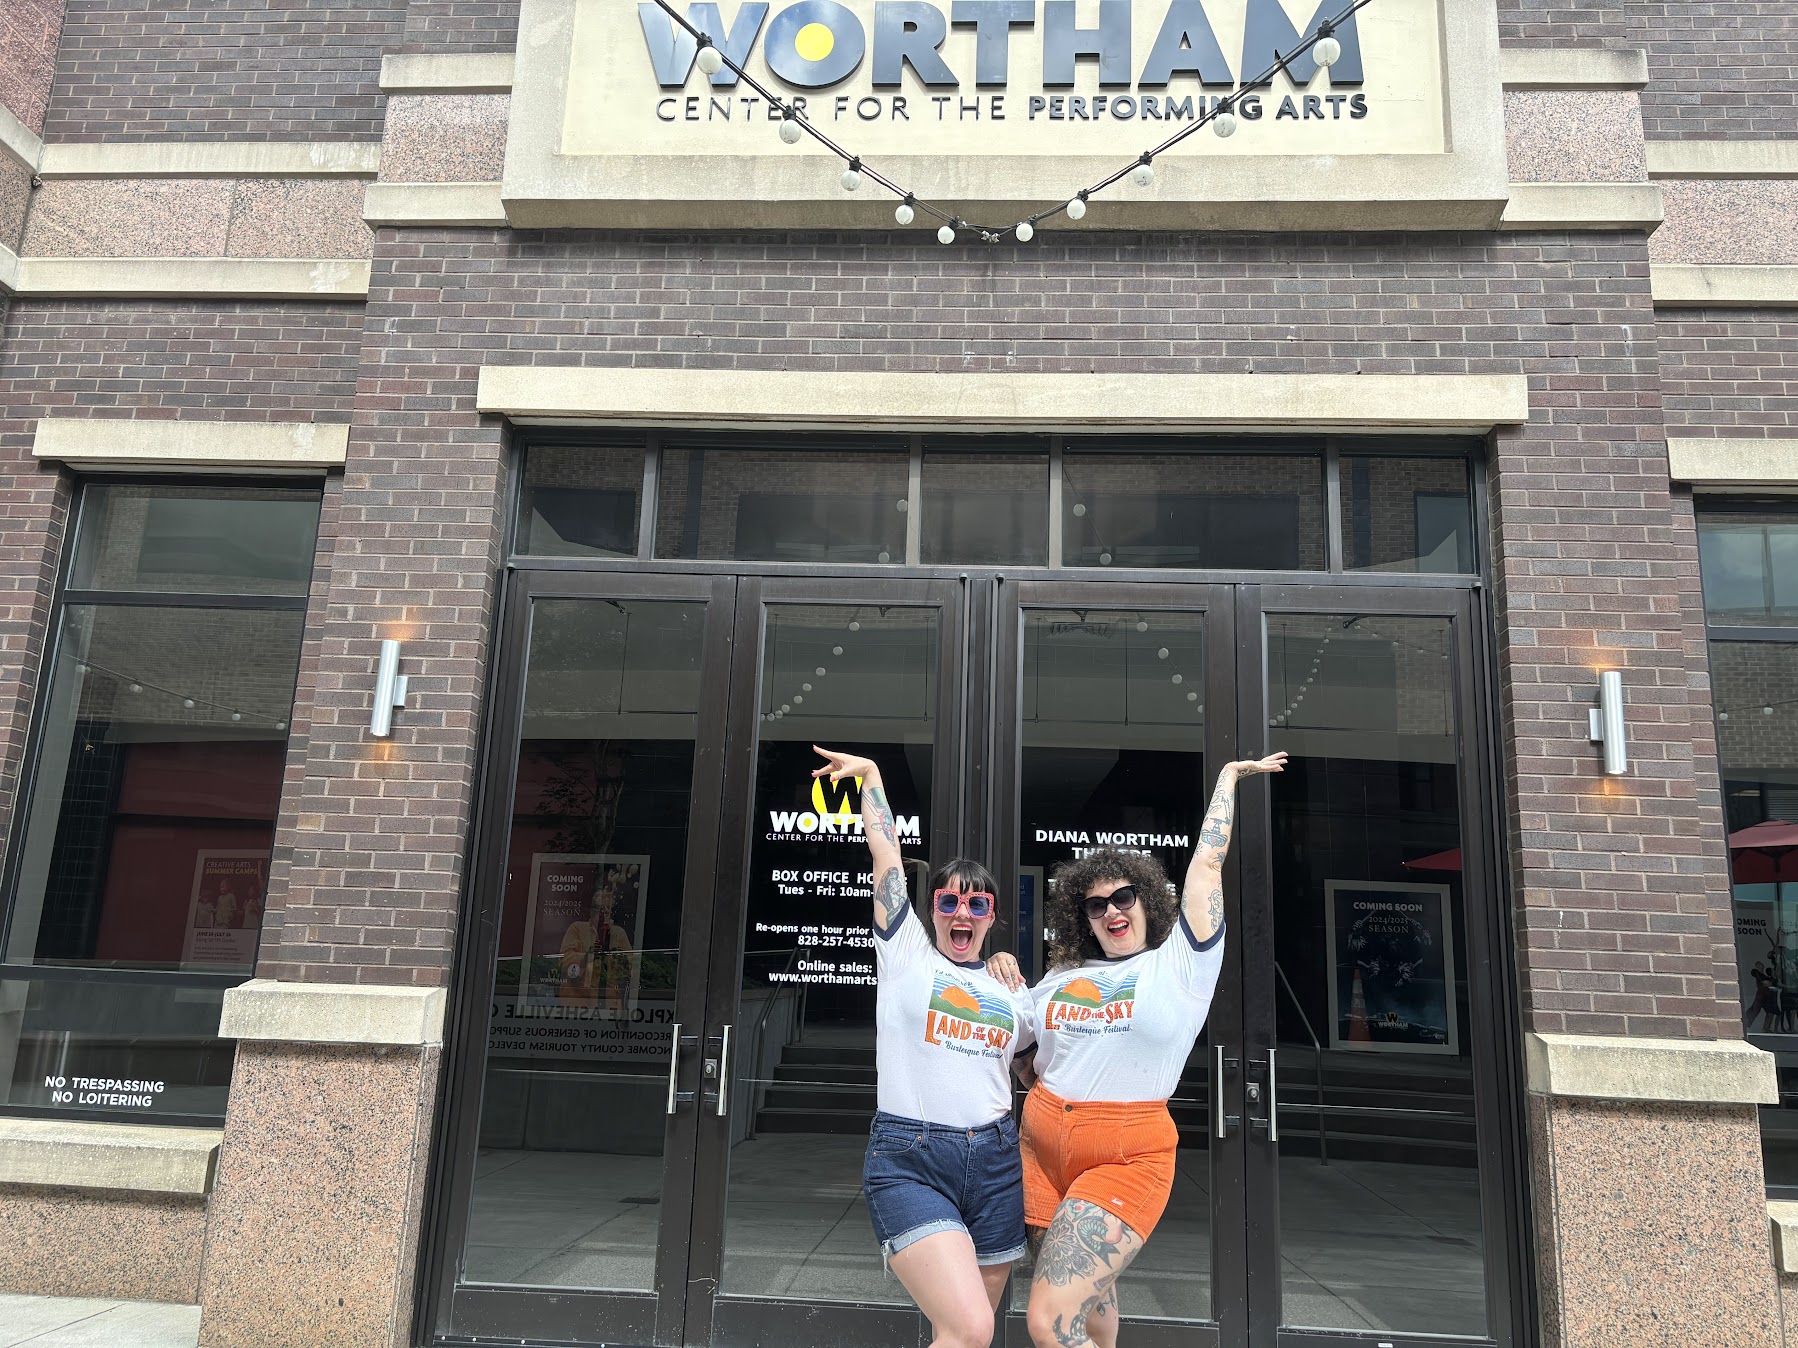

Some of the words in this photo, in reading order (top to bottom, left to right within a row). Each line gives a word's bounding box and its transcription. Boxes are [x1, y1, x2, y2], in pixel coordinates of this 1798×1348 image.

[638, 0, 1365, 89] WORTHAM
[656, 95, 809, 121] CENTER
[834, 95, 910, 122] FOR
[931, 96, 1006, 121] THE
[1276, 94, 1369, 119] ARTS
[769, 811, 920, 837] WORTHM
[766, 833, 802, 842] CENTER
[805, 834, 824, 842] FOR
[827, 835, 845, 843] THE
[1035, 829, 1090, 844] DIANA
[1096, 832, 1189, 848] WORTHAM
[205, 867, 234, 875] SUMMER
[206, 861, 235, 869] CREATIVE
[547, 875, 584, 883] COMING
[772, 870, 799, 882] BOX
[803, 871, 849, 883] OFFICE
[551, 884, 578, 892] SOON
[777, 884, 804, 895] Tues
[816, 885, 836, 896] Fri:
[544, 898, 582, 909] 2024/2025
[1352, 901, 1393, 911] COMING
[1394, 902, 1423, 912] SOON
[543, 907, 581, 917] SEASON
[1368, 915, 1409, 925] 2024/2025
[1736, 918, 1767, 927] OMING
[755, 922, 799, 934] Re-opens
[801, 926, 819, 934] one
[821, 925, 843, 935] hour
[846, 925, 870, 936] prior
[1368, 924, 1409, 934] SEASON
[1737, 927, 1762, 936] SOON
[797, 935, 875, 948] 828-257-4530
[797, 960, 836, 972] Online
[839, 962, 873, 973] sales:
[1045, 1001, 1092, 1031] LAND
[1105, 1000, 1135, 1025] SKY
[924, 1010, 973, 1046] LAND
[975, 1025, 986, 1033] OF
[1064, 1023, 1102, 1037] Burlesque
[972, 1031, 987, 1041] THE
[984, 1026, 1013, 1050] SKY
[944, 1039, 981, 1057] Burlesque
[44, 1075, 67, 1088] NO
[72, 1077, 165, 1093] TRESPASSING
[51, 1091, 74, 1104] NO
[78, 1093, 153, 1107] LOITERING
